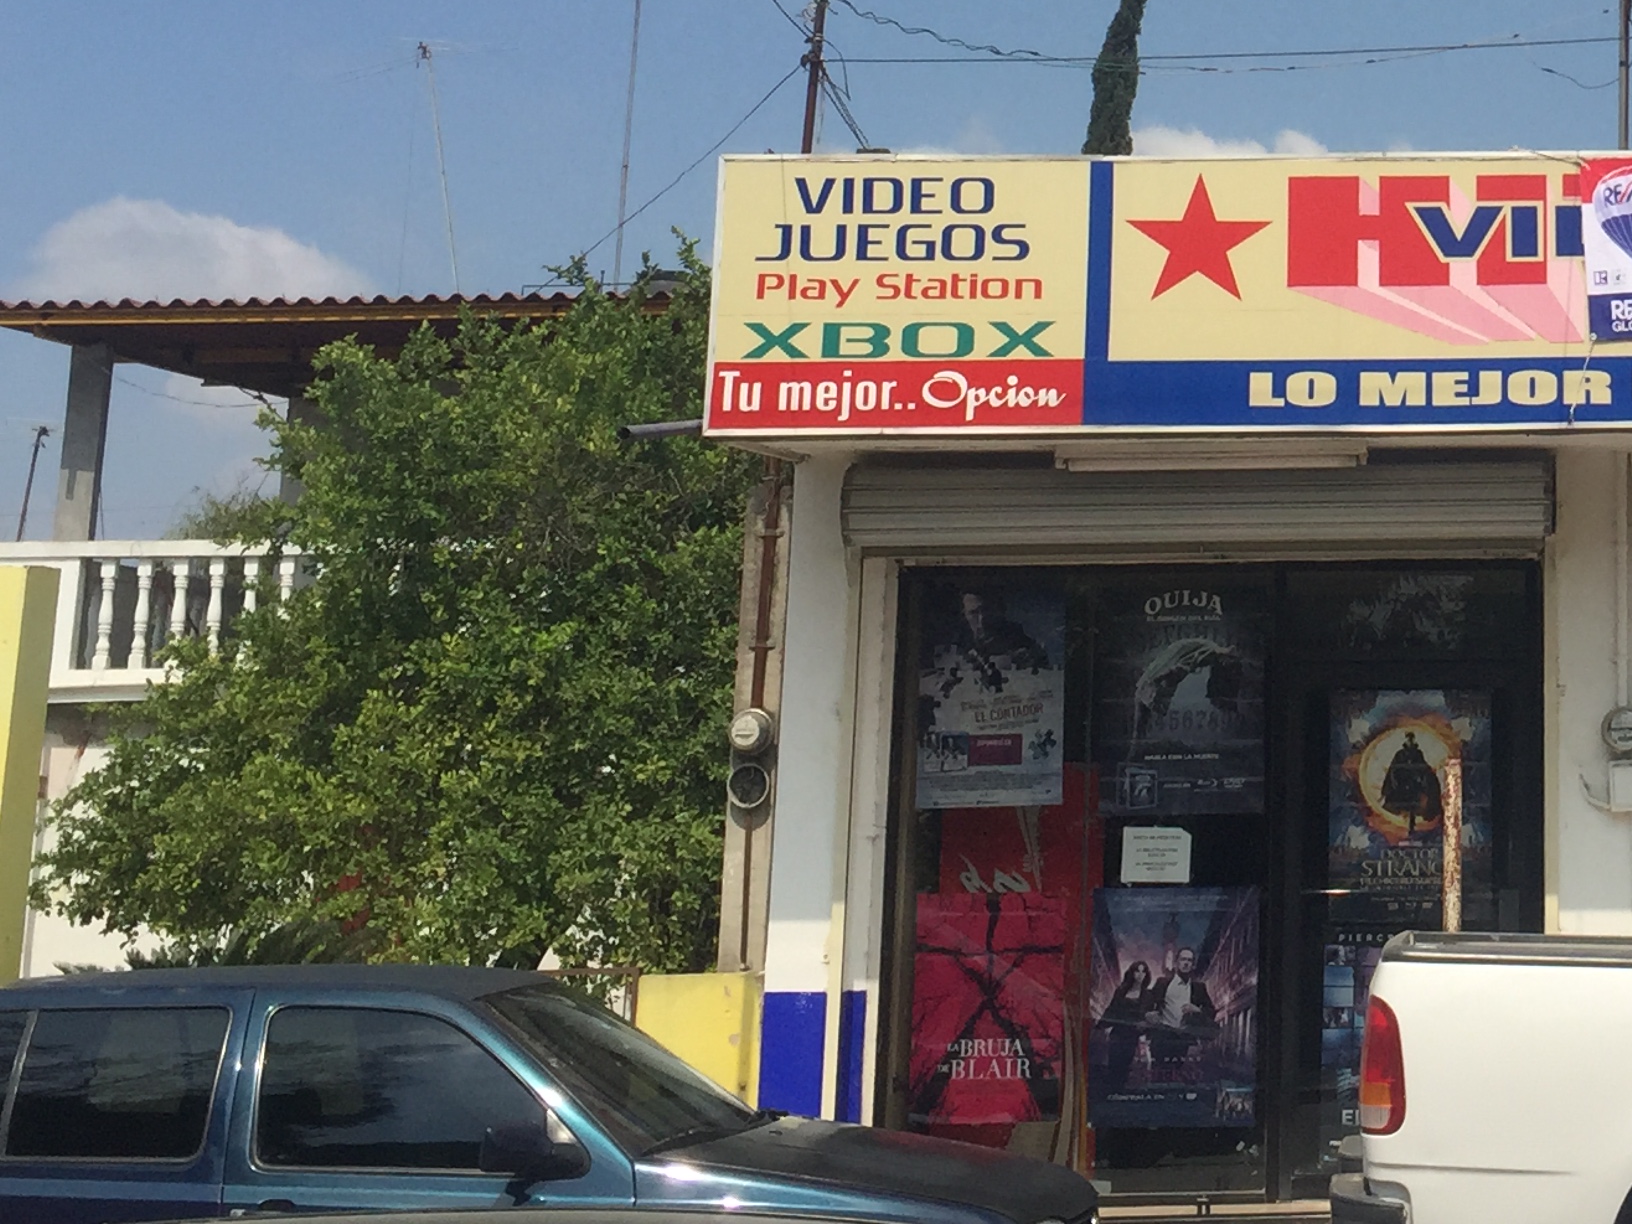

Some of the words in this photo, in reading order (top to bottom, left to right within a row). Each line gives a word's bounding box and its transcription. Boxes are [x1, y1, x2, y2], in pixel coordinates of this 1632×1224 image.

[795, 177, 995, 215] VIDEO
[754, 223, 1031, 262] JUEGOS
[755, 273, 861, 308] Play
[876, 272, 1044, 301] Station
[743, 320, 1056, 359] XBOX
[718, 370, 763, 413] Tu
[921, 370, 1067, 421] Opcion
[1248, 371, 1338, 408] LO
[1359, 367, 1616, 407] MEJOR
[1143, 589, 1224, 616] OUIJA
[989, 703, 1045, 722] CONTADOR
[1380, 847, 1440, 860] DOCTOR
[959, 1038, 1027, 1058] BRUJA
[950, 1057, 1033, 1080] BLAIR
